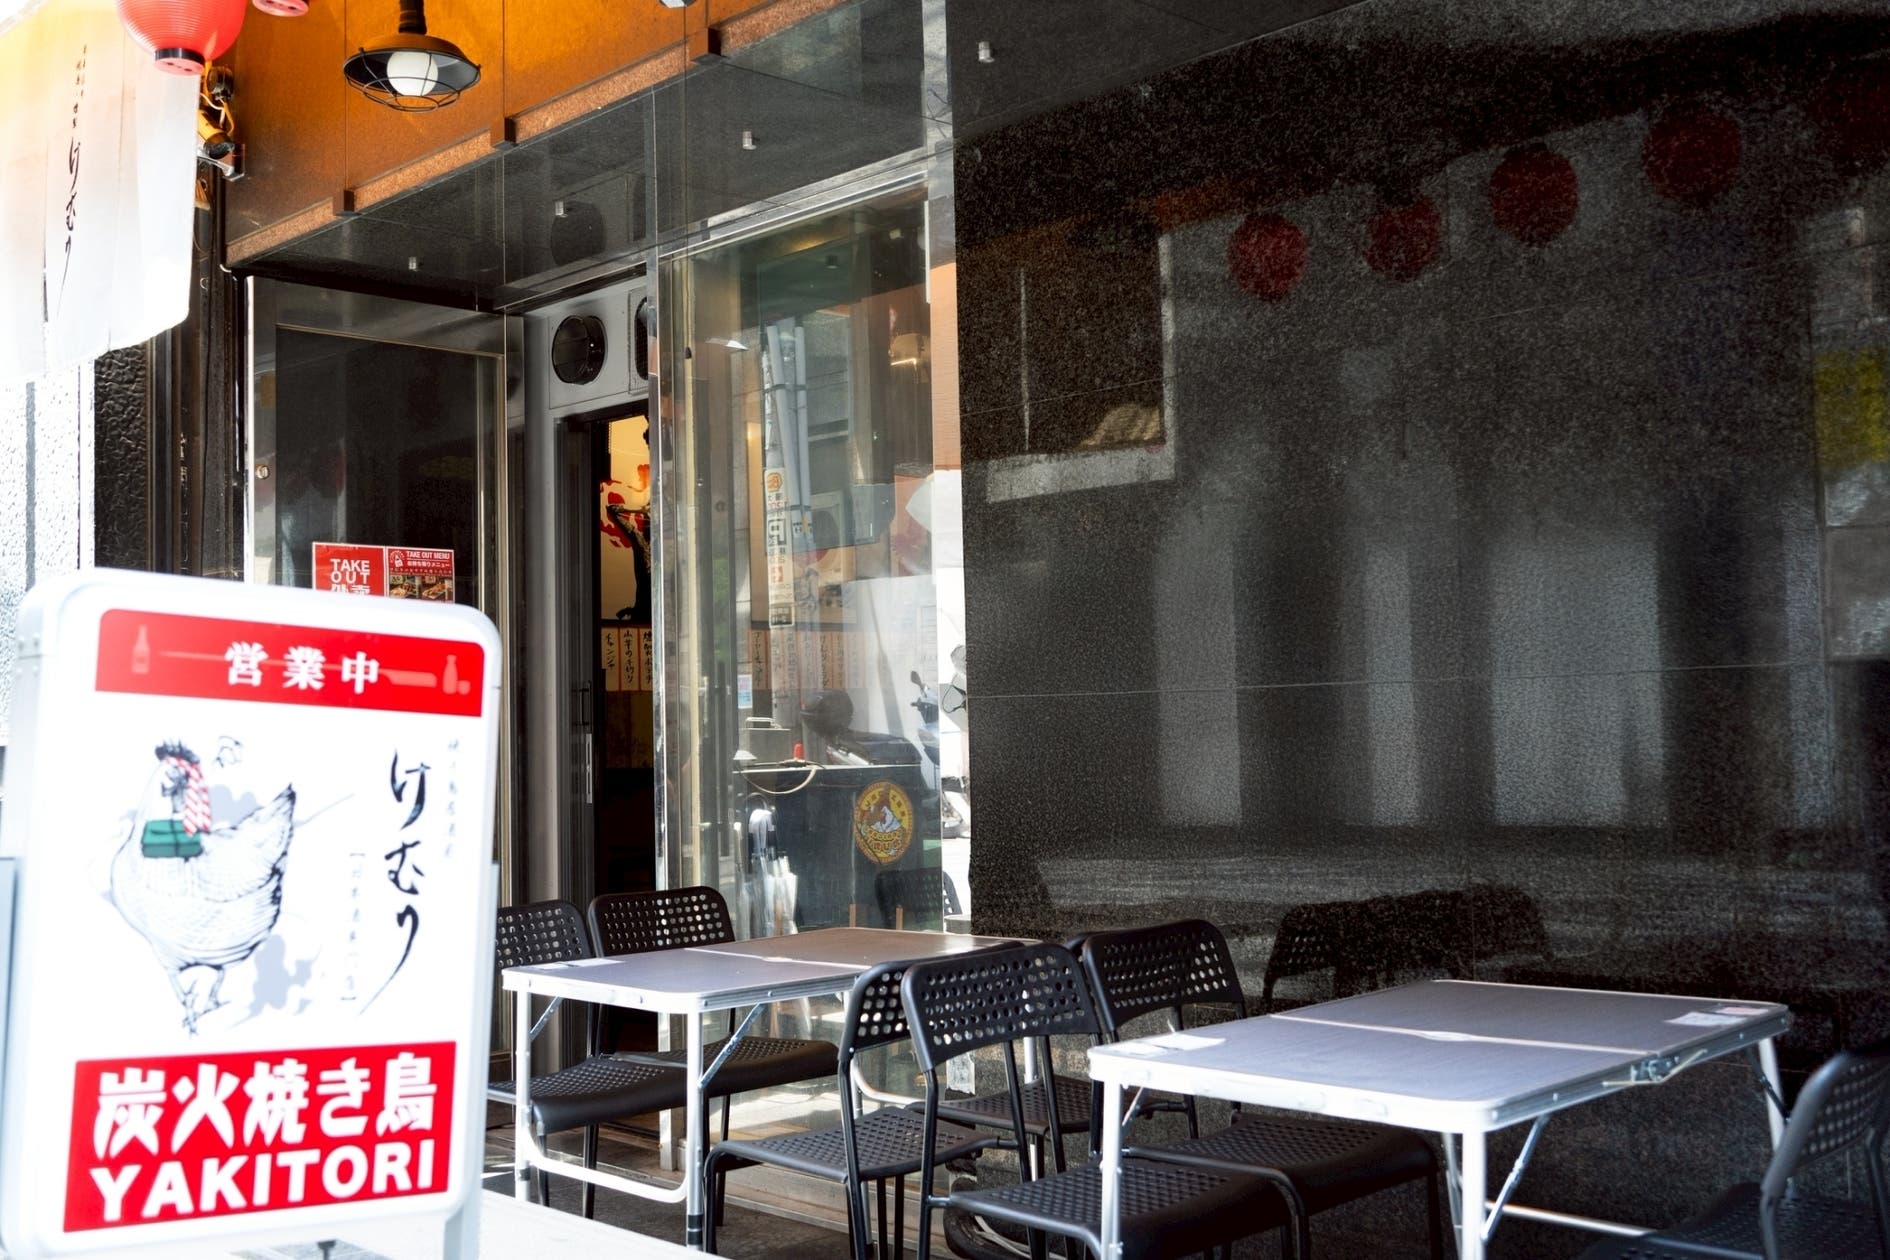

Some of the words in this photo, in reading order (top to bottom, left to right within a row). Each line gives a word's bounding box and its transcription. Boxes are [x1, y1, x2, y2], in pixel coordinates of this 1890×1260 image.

[330, 558, 370, 572] TAKE
[330, 571, 370, 585] OUT
[406, 550, 421, 559] TAKE
[422, 551, 433, 559] OUT
[433, 552, 450, 560] MENU
[224, 641, 380, 694] 営業中
[359, 748, 431, 1016] けむり
[93, 1052, 437, 1160] 炭火焼き鳥
[91, 1140, 434, 1222] YAKITORI
